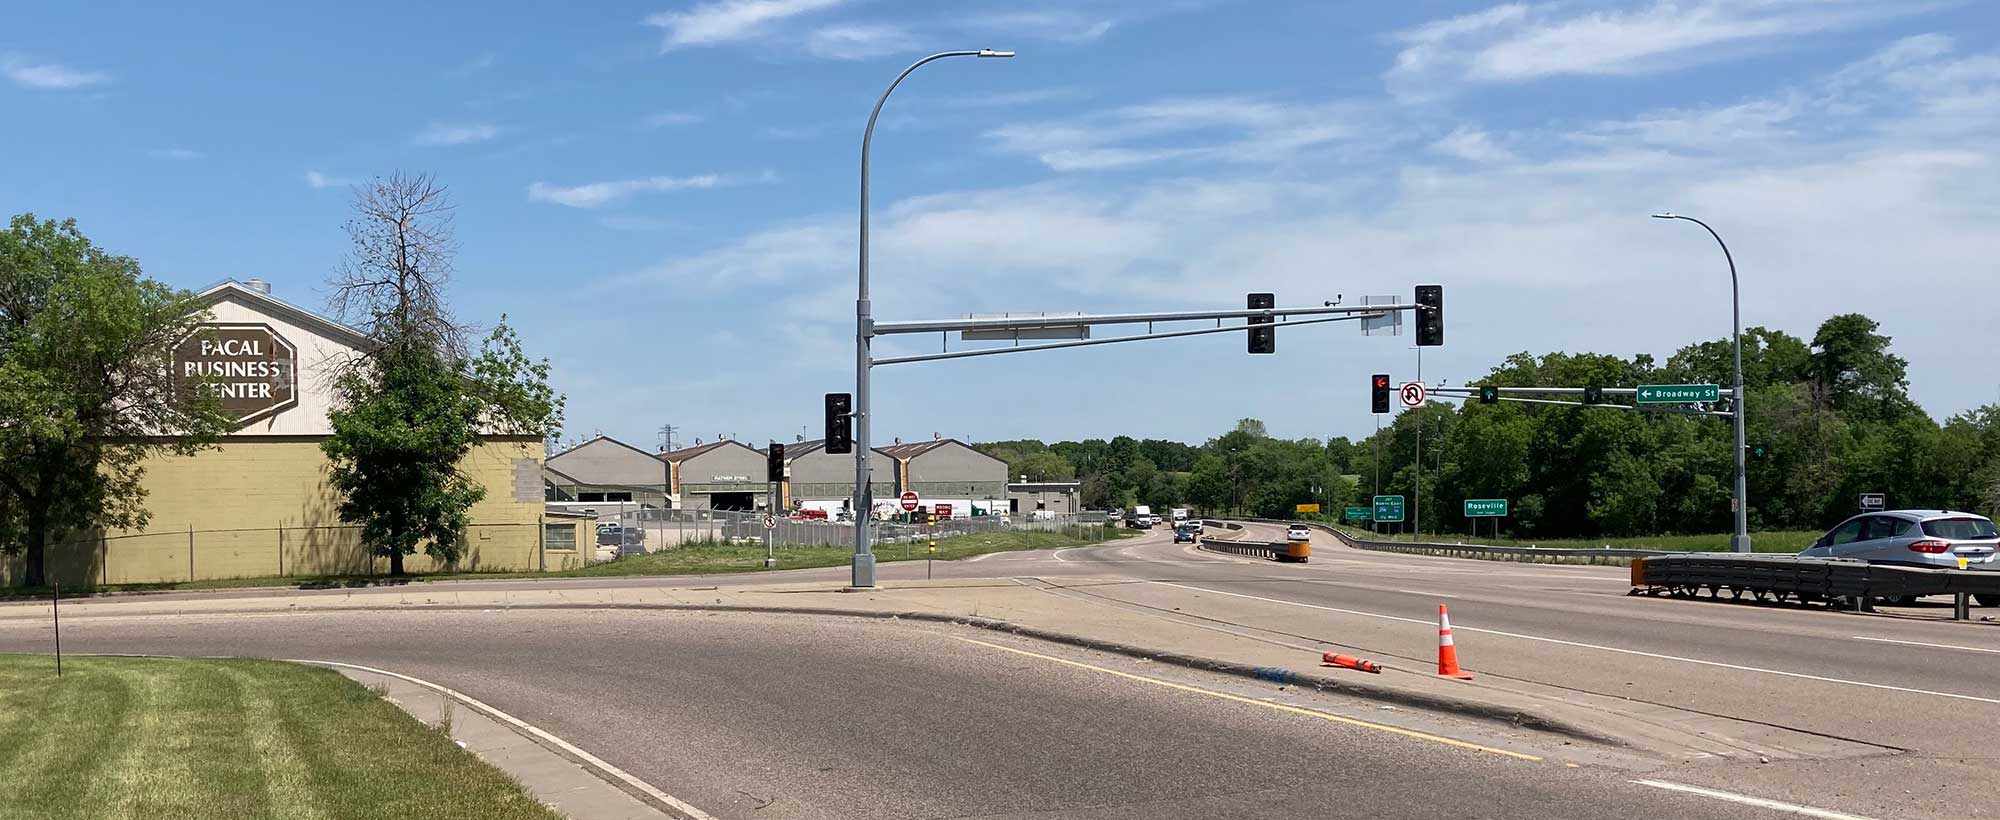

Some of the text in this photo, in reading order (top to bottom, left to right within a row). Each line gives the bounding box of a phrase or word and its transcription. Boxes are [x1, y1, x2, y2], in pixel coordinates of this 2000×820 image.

[201, 340, 263, 356] PACAL
[184, 361, 280, 377] BUSINESS
[1656, 389, 1715, 399] Broadway St
